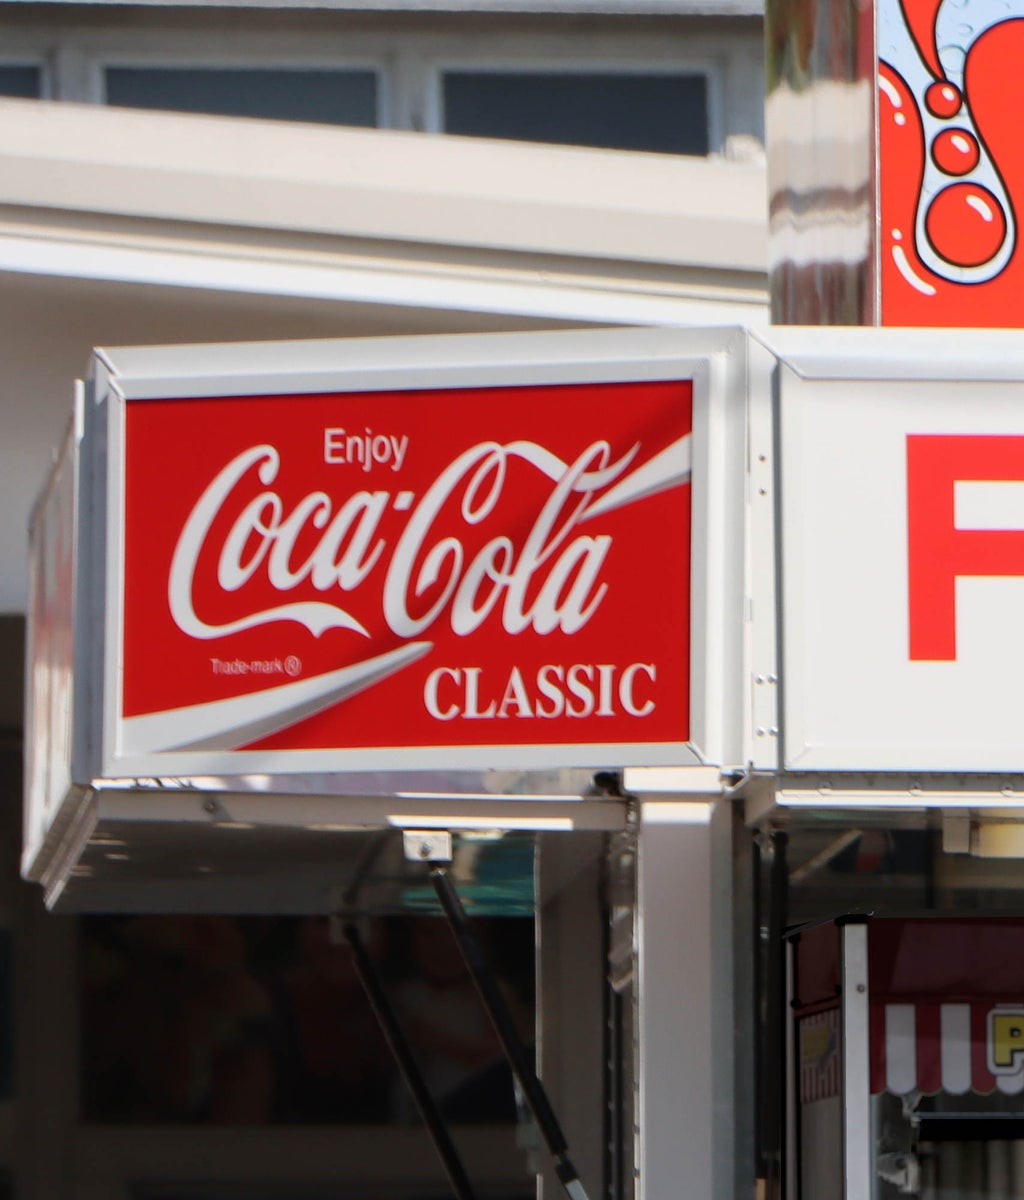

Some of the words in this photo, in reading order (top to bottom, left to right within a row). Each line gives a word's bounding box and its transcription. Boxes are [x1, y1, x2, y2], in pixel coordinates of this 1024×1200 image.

[323, 427, 409, 471] Enjoy
[168, 440, 642, 640] Coca-Cola
[423, 662, 658, 722] CLASSIC
